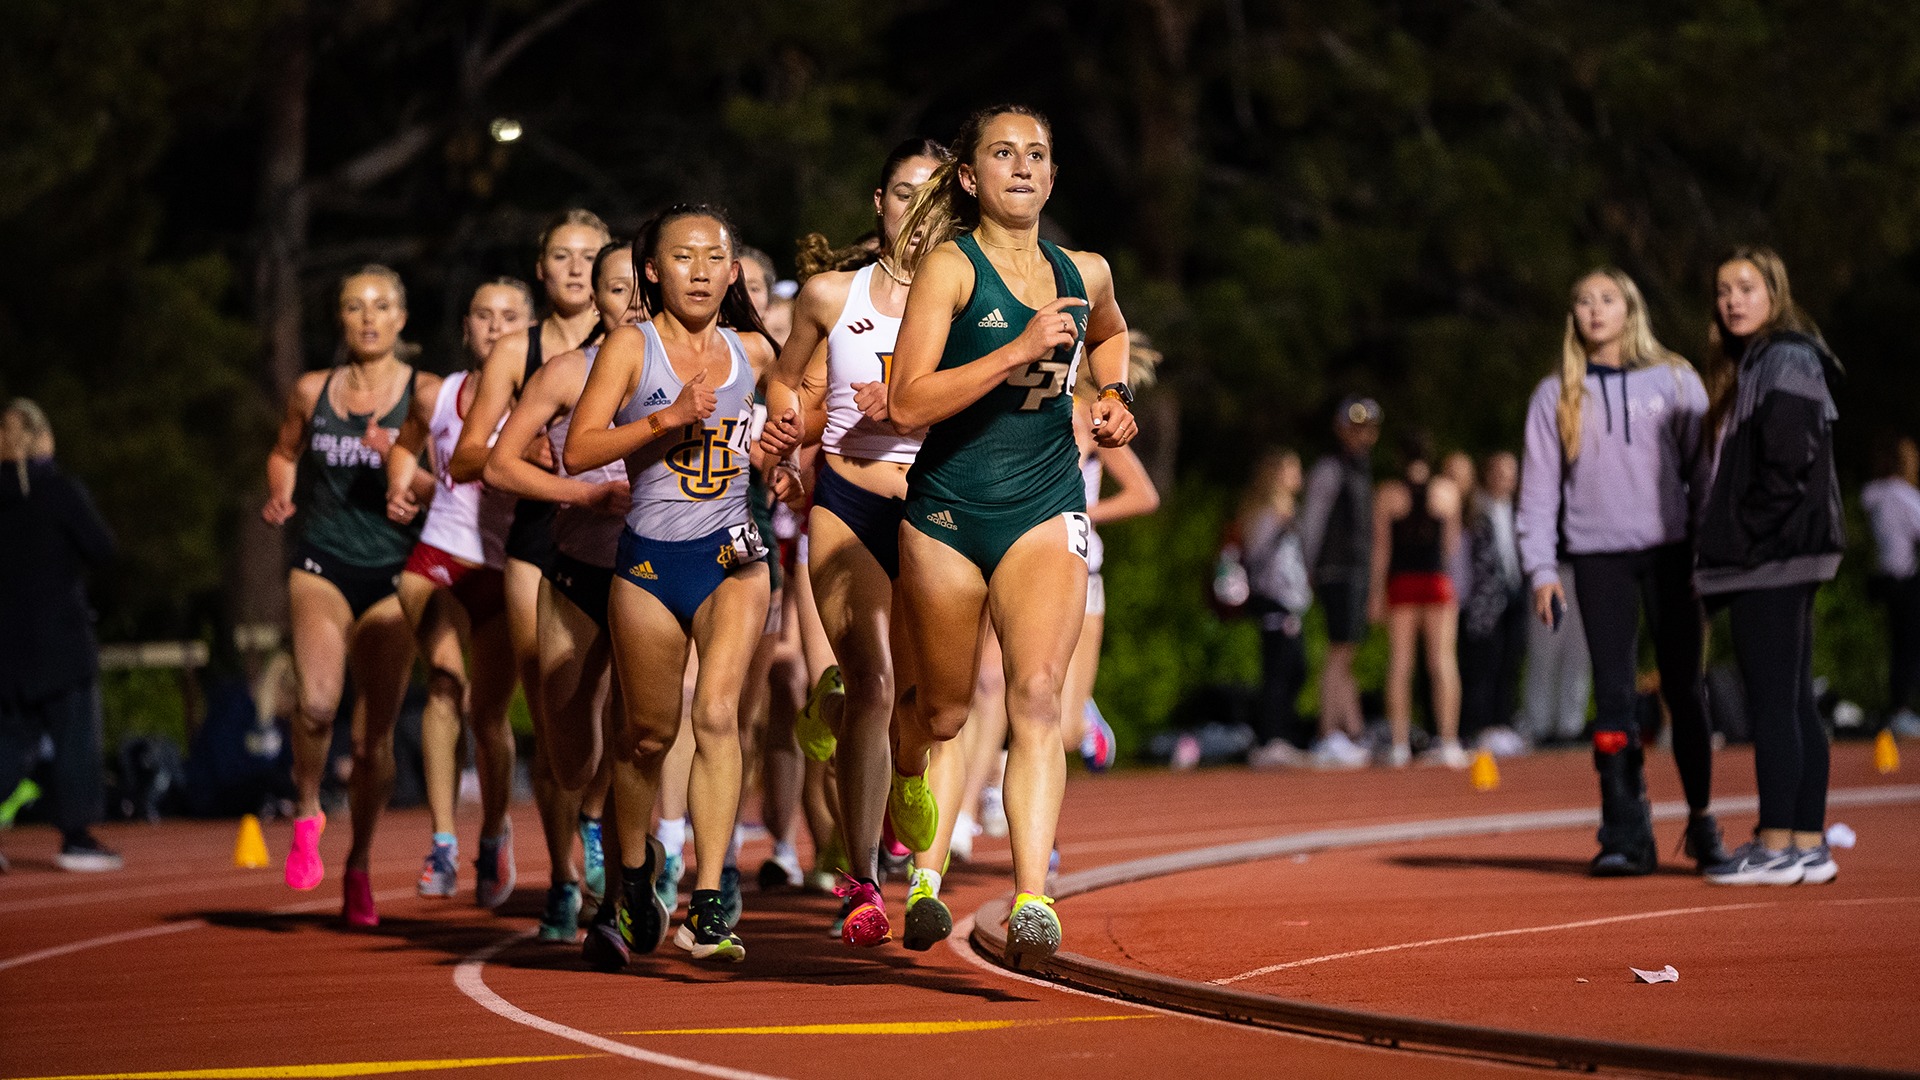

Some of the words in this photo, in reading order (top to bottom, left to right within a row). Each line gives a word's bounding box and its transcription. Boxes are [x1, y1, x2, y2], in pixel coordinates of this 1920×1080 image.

[978, 320, 1009, 328] adidas
[643, 399, 672, 407] adidas
[326, 446, 382, 469] STATE
[926, 513, 959, 531] adidas
[629, 567, 659, 581] adidas
